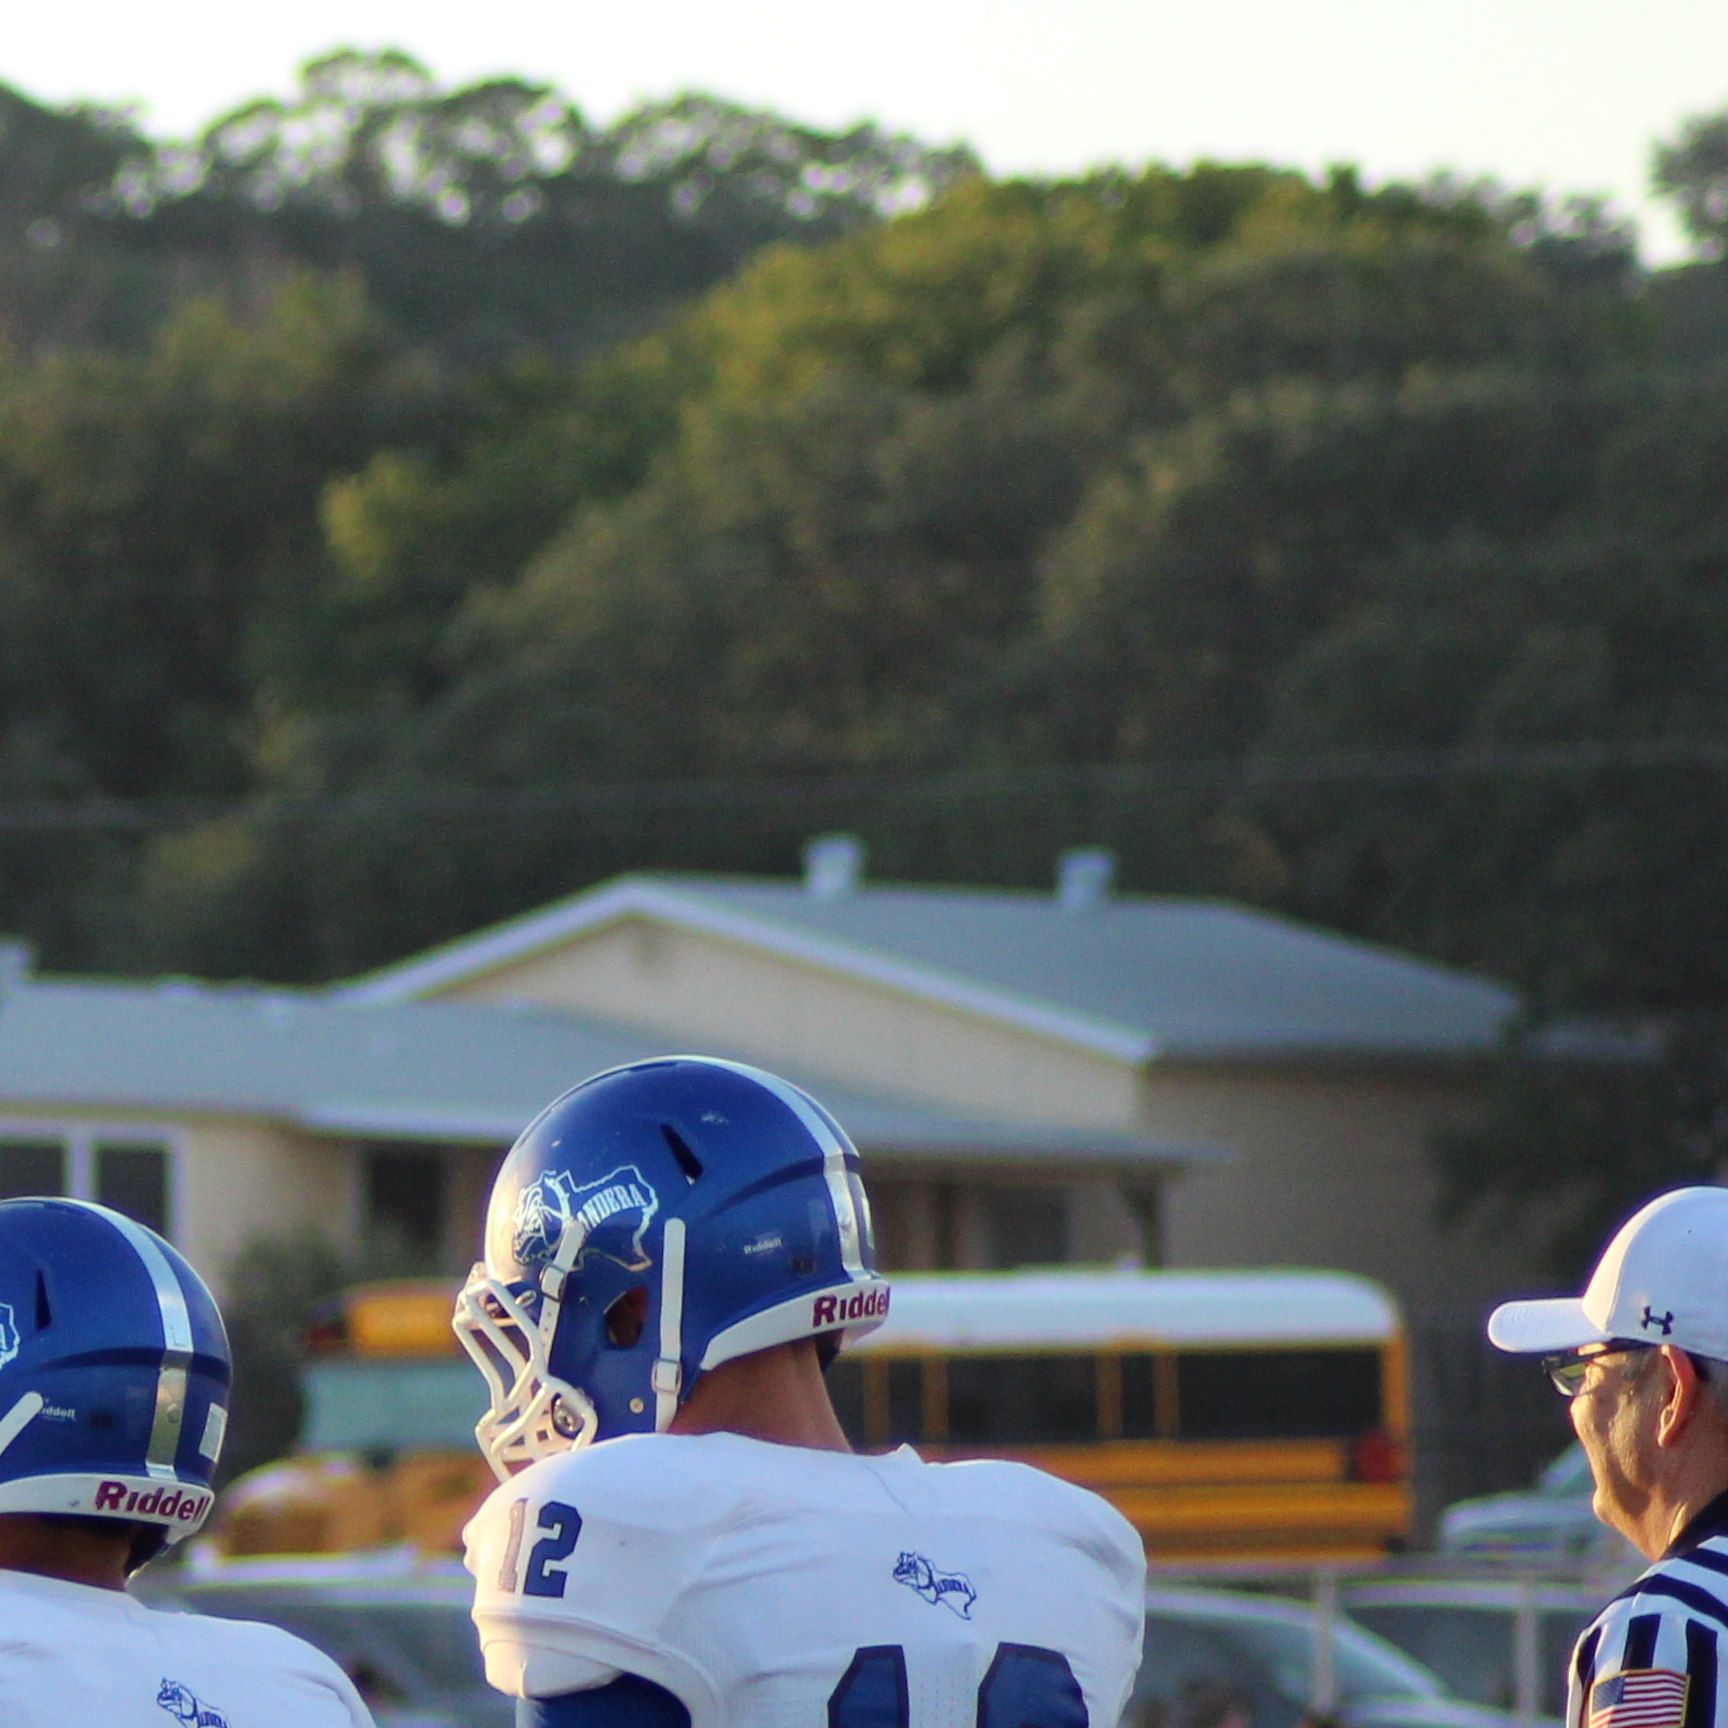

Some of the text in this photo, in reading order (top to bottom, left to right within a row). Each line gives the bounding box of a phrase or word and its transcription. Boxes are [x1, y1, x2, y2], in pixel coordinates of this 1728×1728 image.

[577, 1184, 647, 1232] ANDERA
[812, 1286, 891, 1328] Riddel
[42, 1406, 76, 1418] iddell
[95, 1480, 210, 1523] Riddell
[498, 1498, 582, 1598] 12
